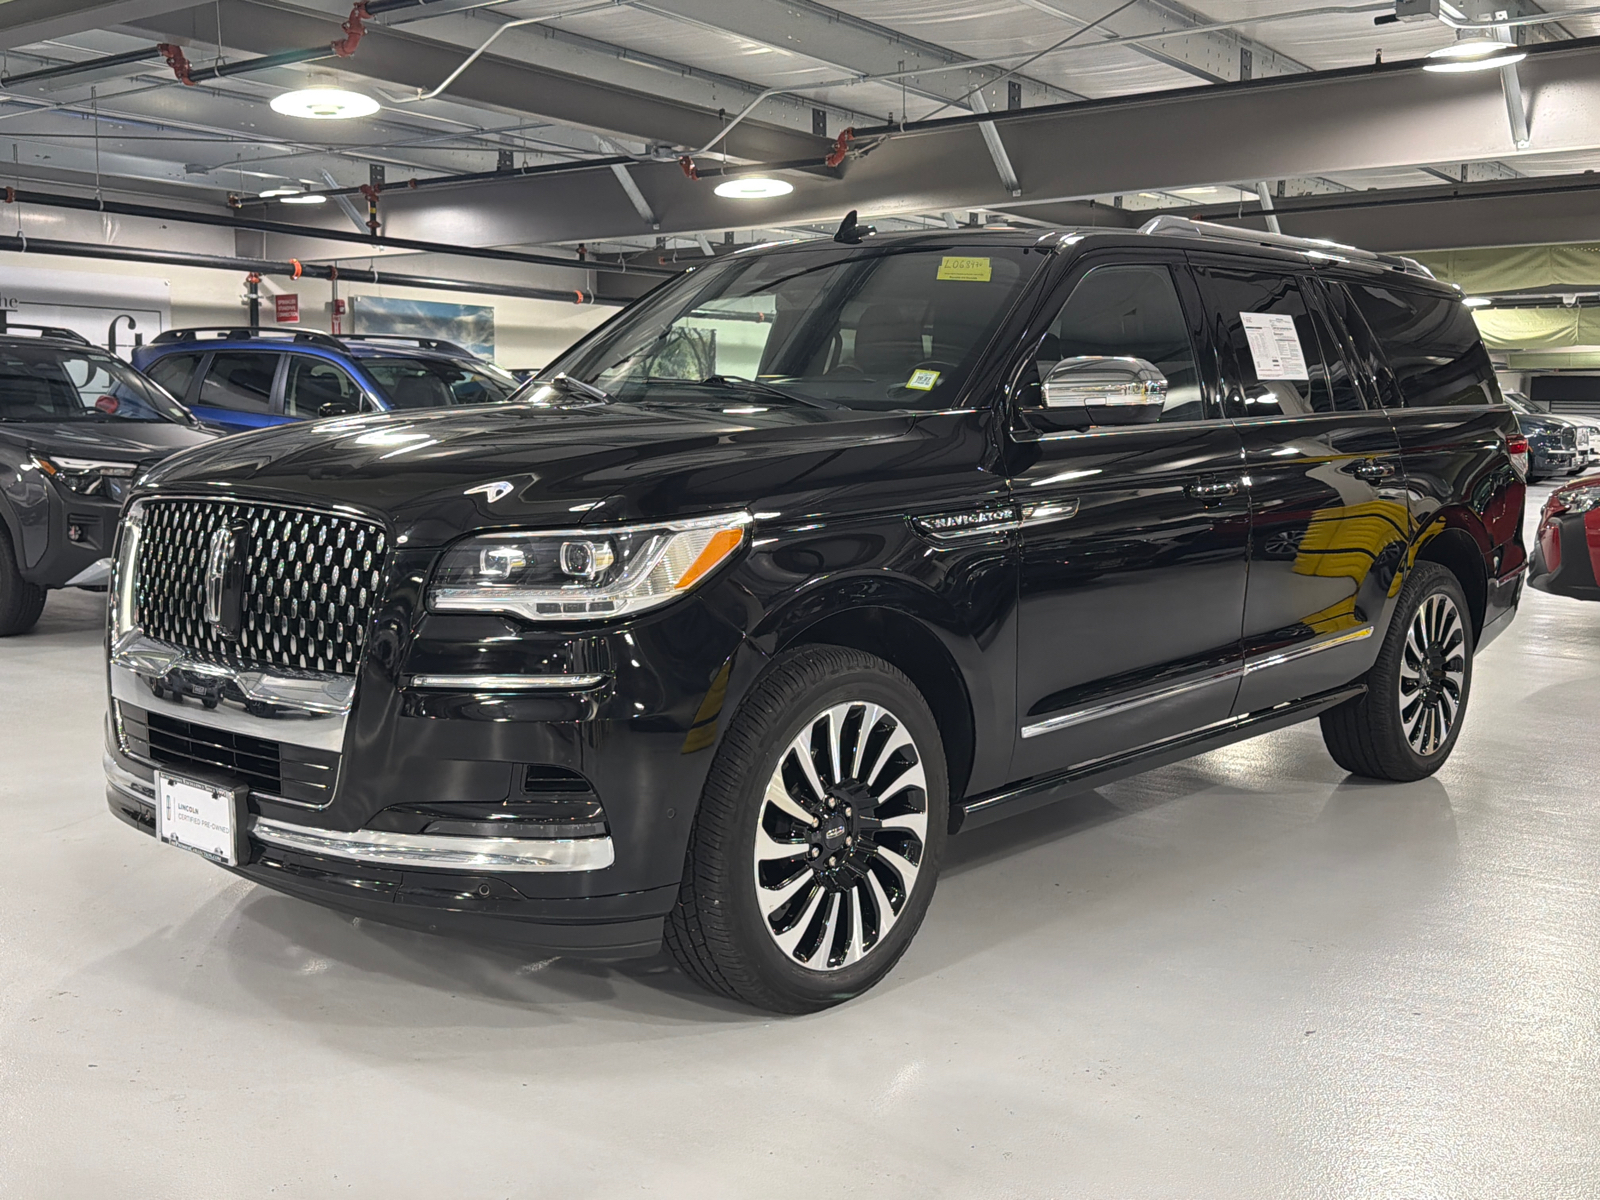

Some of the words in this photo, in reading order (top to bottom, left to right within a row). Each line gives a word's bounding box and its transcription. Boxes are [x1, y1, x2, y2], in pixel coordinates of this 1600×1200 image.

[935, 509, 1013, 528] NAVIGATOR
[178, 803, 199, 814] LINCOLN
[178, 813, 200, 825] CERTIFIED
[201, 820, 229, 834] PRE-OWNED
